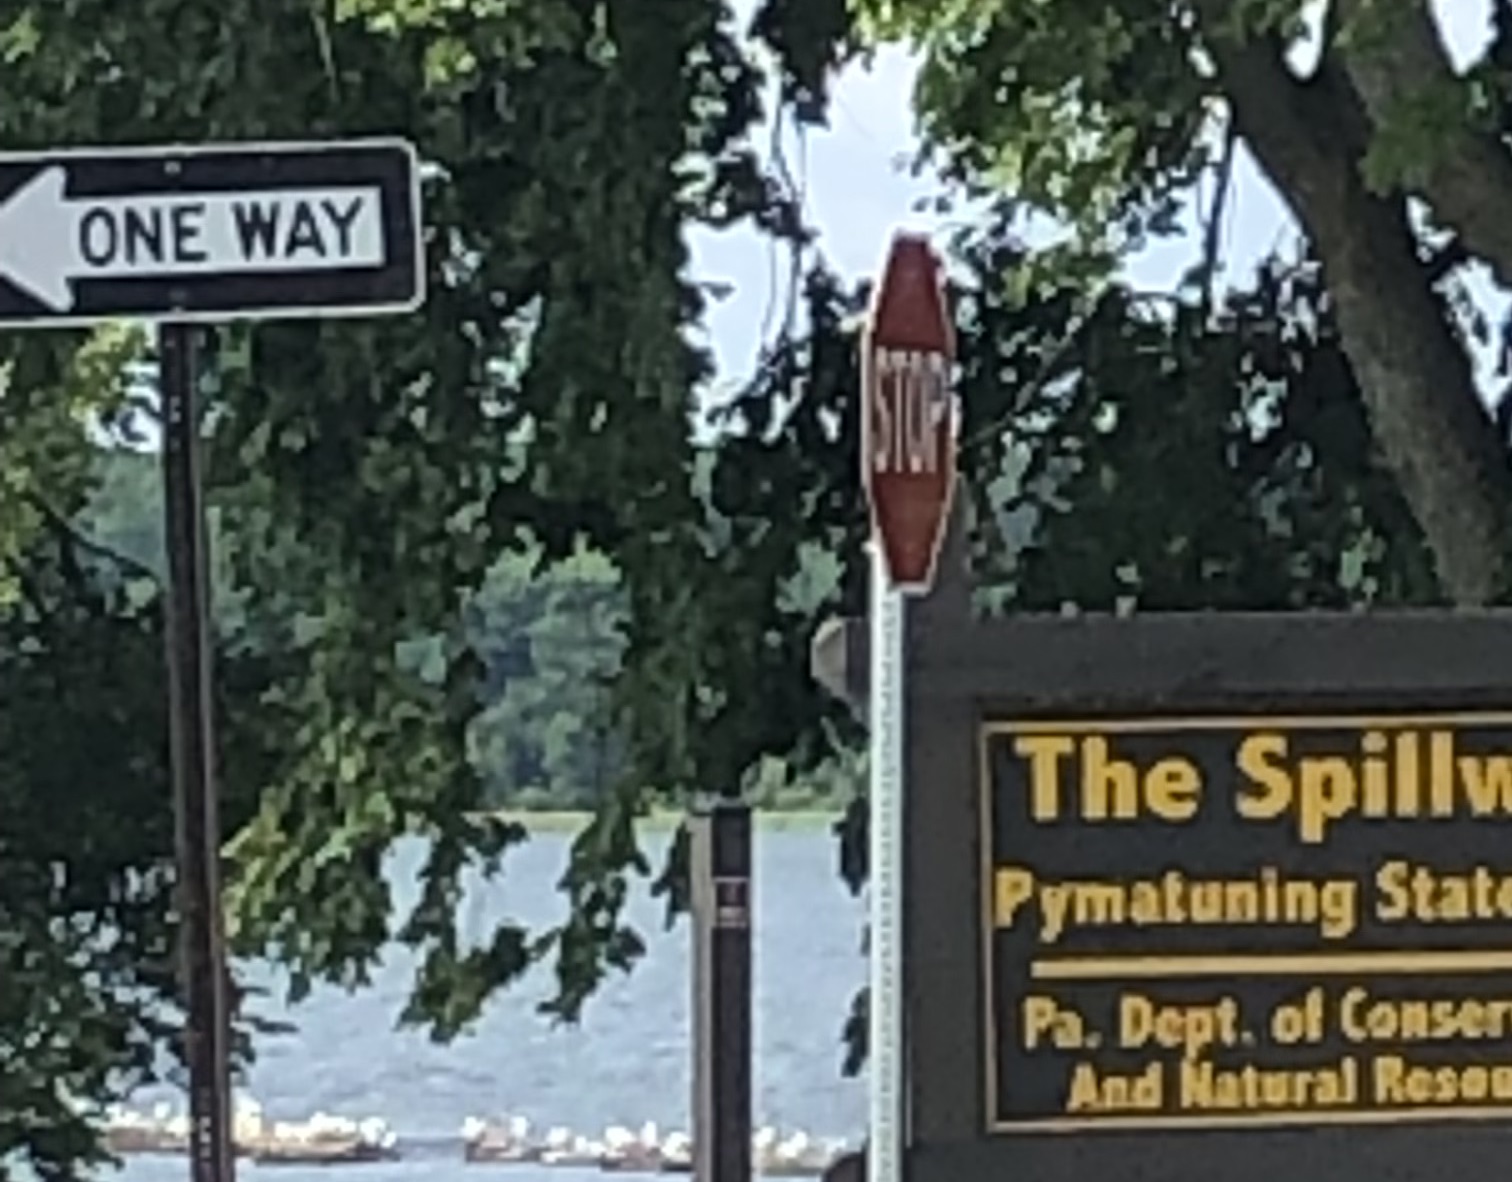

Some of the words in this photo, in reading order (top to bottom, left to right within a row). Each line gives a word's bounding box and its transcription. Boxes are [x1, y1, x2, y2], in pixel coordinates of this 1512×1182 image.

[78, 203, 207, 267] ONE
[233, 196, 362, 262] WAY
[874, 346, 947, 473] STOP
[1013, 734, 1200, 821] The
[994, 868, 1357, 943] Pymatuning
[1023, 997, 1101, 1050] Pa.
[1119, 995, 1255, 1058] Dept.
[1271, 991, 1324, 1045] of
[1066, 1063, 1162, 1112] And
[1180, 1058, 1357, 1112] Natural
